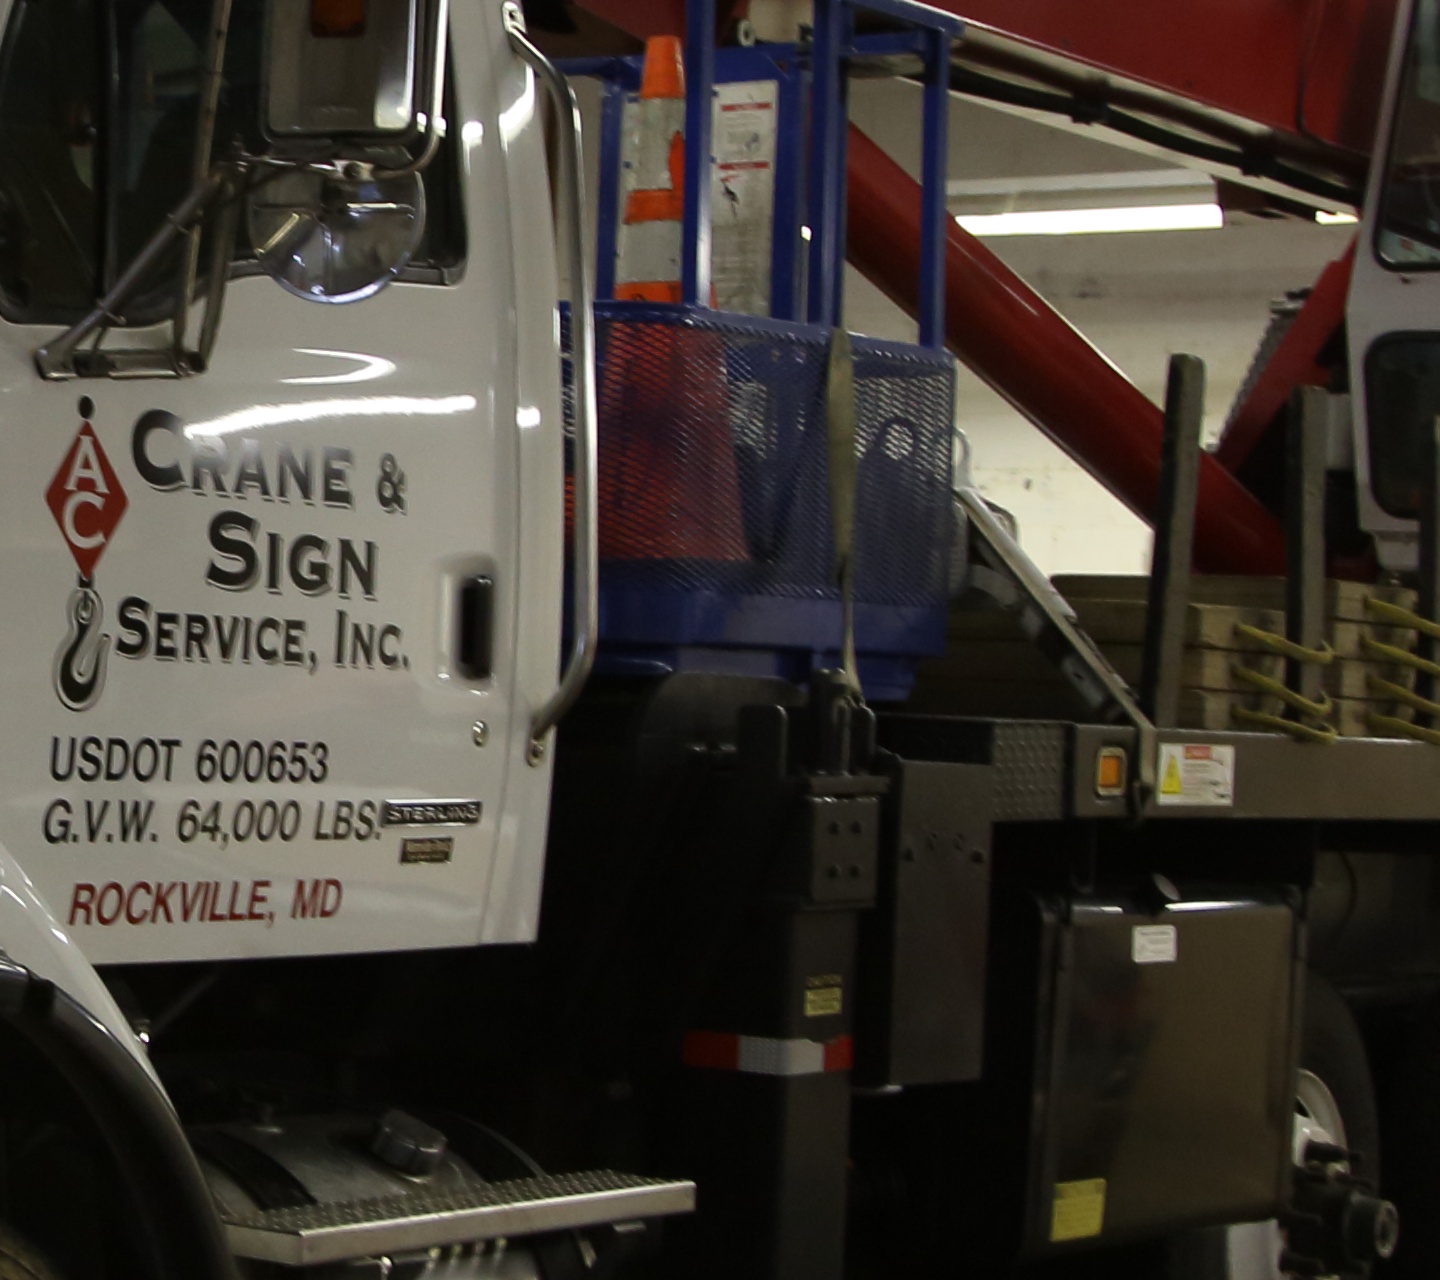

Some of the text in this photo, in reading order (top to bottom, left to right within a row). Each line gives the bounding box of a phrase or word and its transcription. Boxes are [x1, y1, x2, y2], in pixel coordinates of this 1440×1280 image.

[130, 409, 409, 515] CRANE &
[205, 510, 379, 600] SIGN
[115, 596, 411, 675] SERVICE, INC.
[51, 736, 330, 784] USDOT 600653
[42, 798, 382, 847] G.V.W. 64,000 LBS.
[387, 803, 479, 822] STERLING
[68, 878, 343, 928] ROCKVILLE, MD
